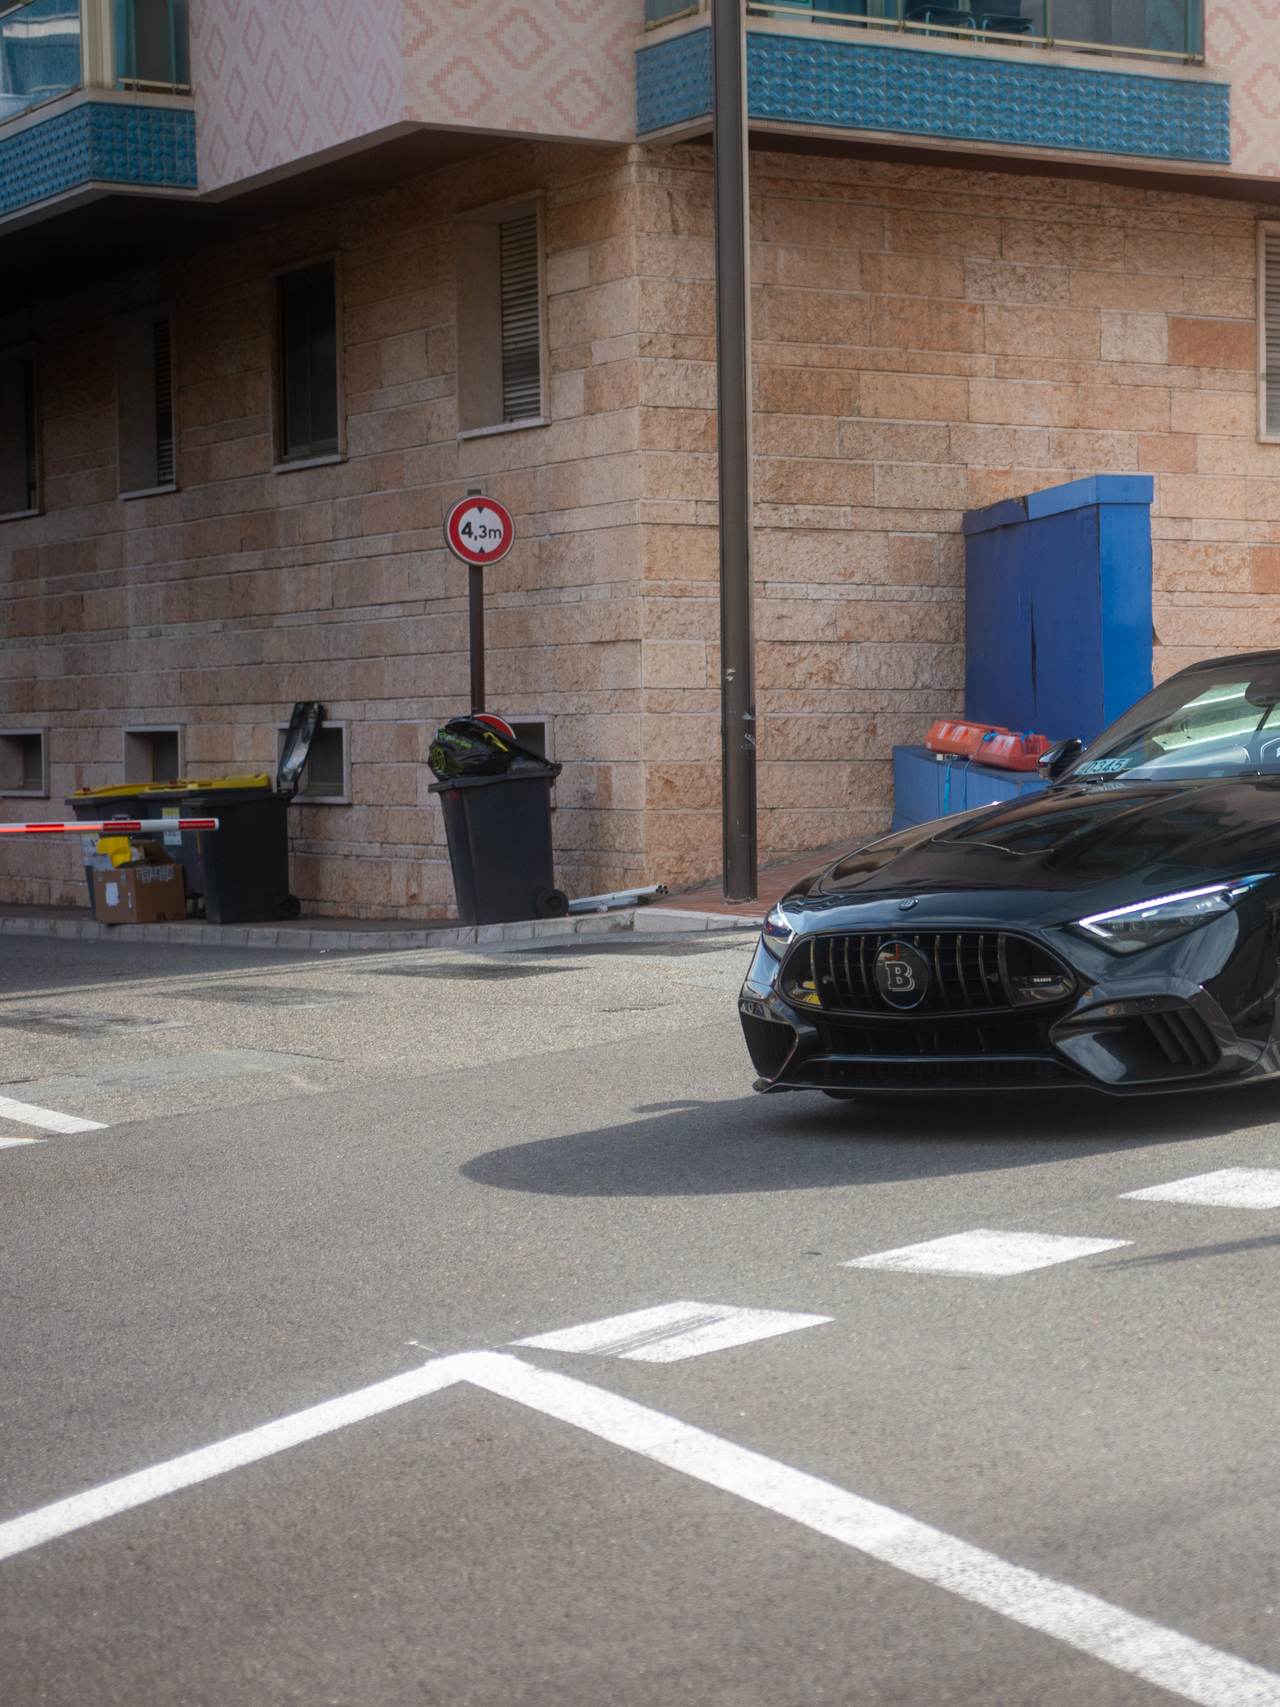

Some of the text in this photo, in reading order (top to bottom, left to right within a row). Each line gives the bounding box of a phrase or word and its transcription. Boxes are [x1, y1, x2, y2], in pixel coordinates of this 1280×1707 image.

[461, 521, 501, 541] 4,3m
[1085, 760, 1125, 774] 0345
[885, 961, 915, 992] B
